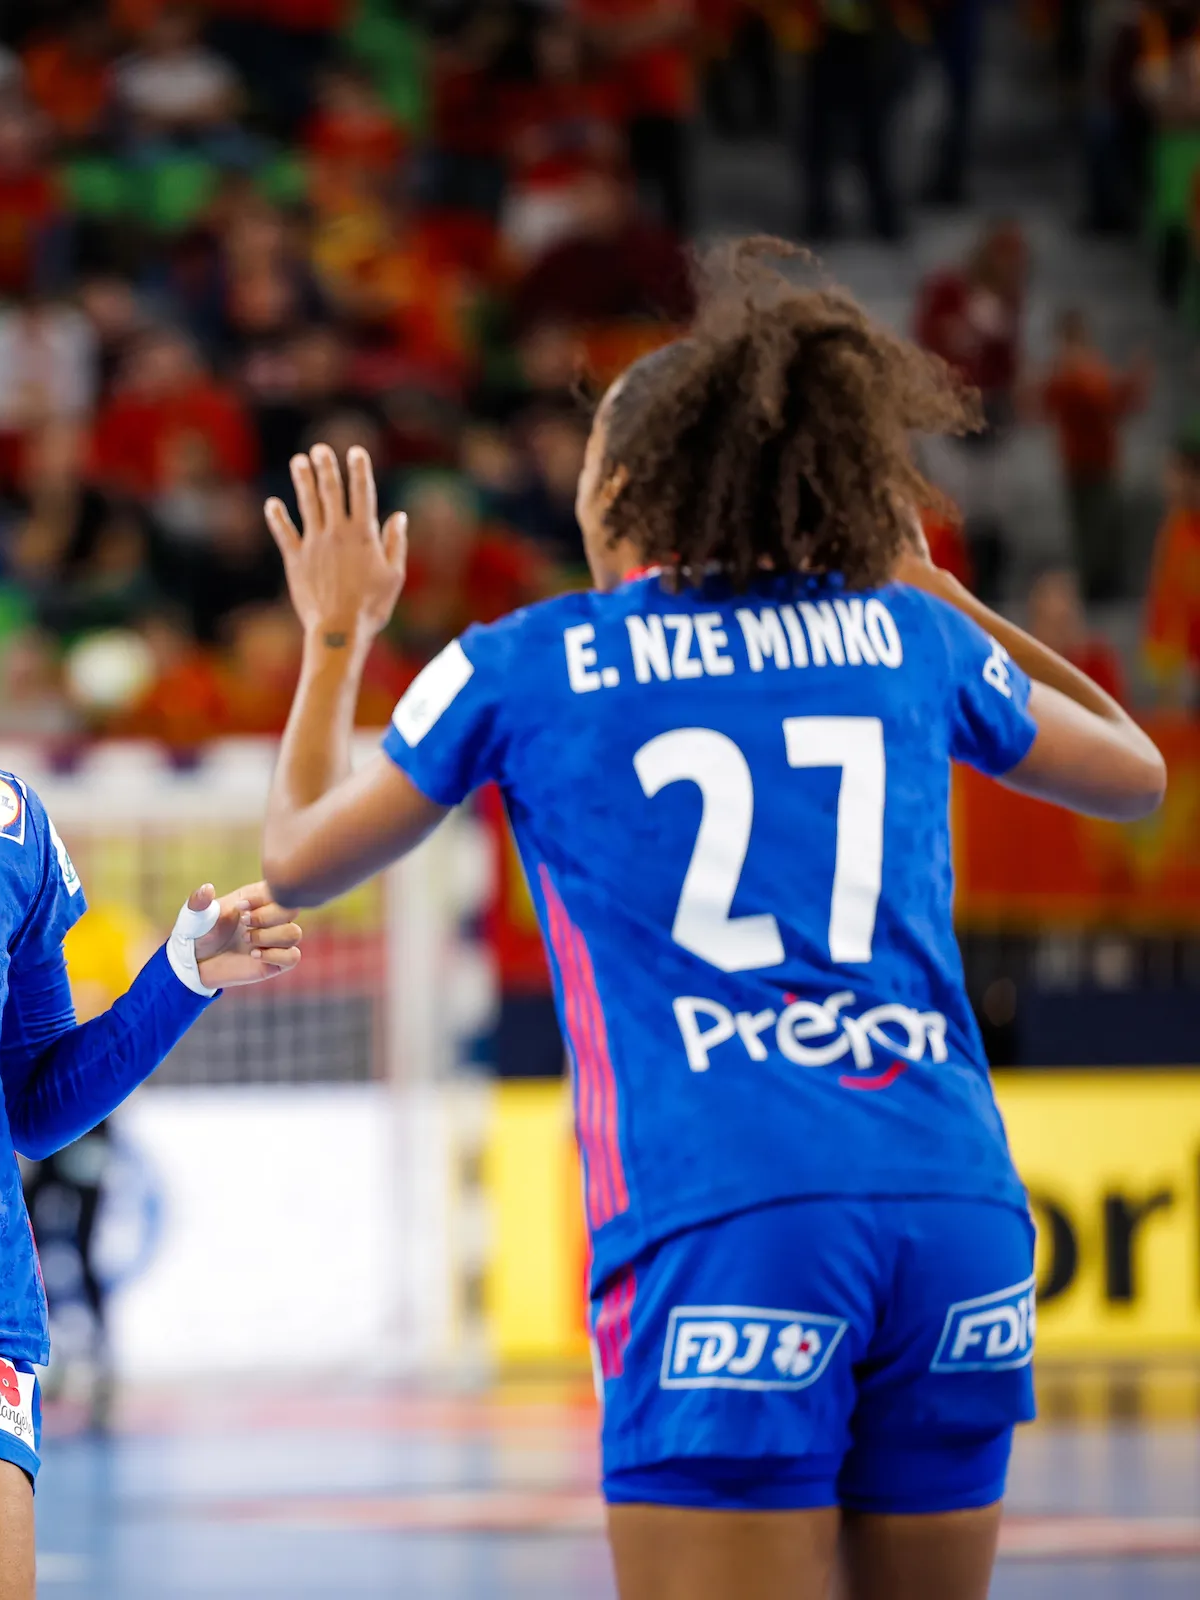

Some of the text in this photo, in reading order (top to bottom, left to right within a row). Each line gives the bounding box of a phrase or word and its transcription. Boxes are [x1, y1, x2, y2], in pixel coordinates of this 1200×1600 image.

[563, 598, 904, 694] E. NZE MINKO
[633, 716, 886, 973] 27
[672, 1320, 771, 1376] FDJ
